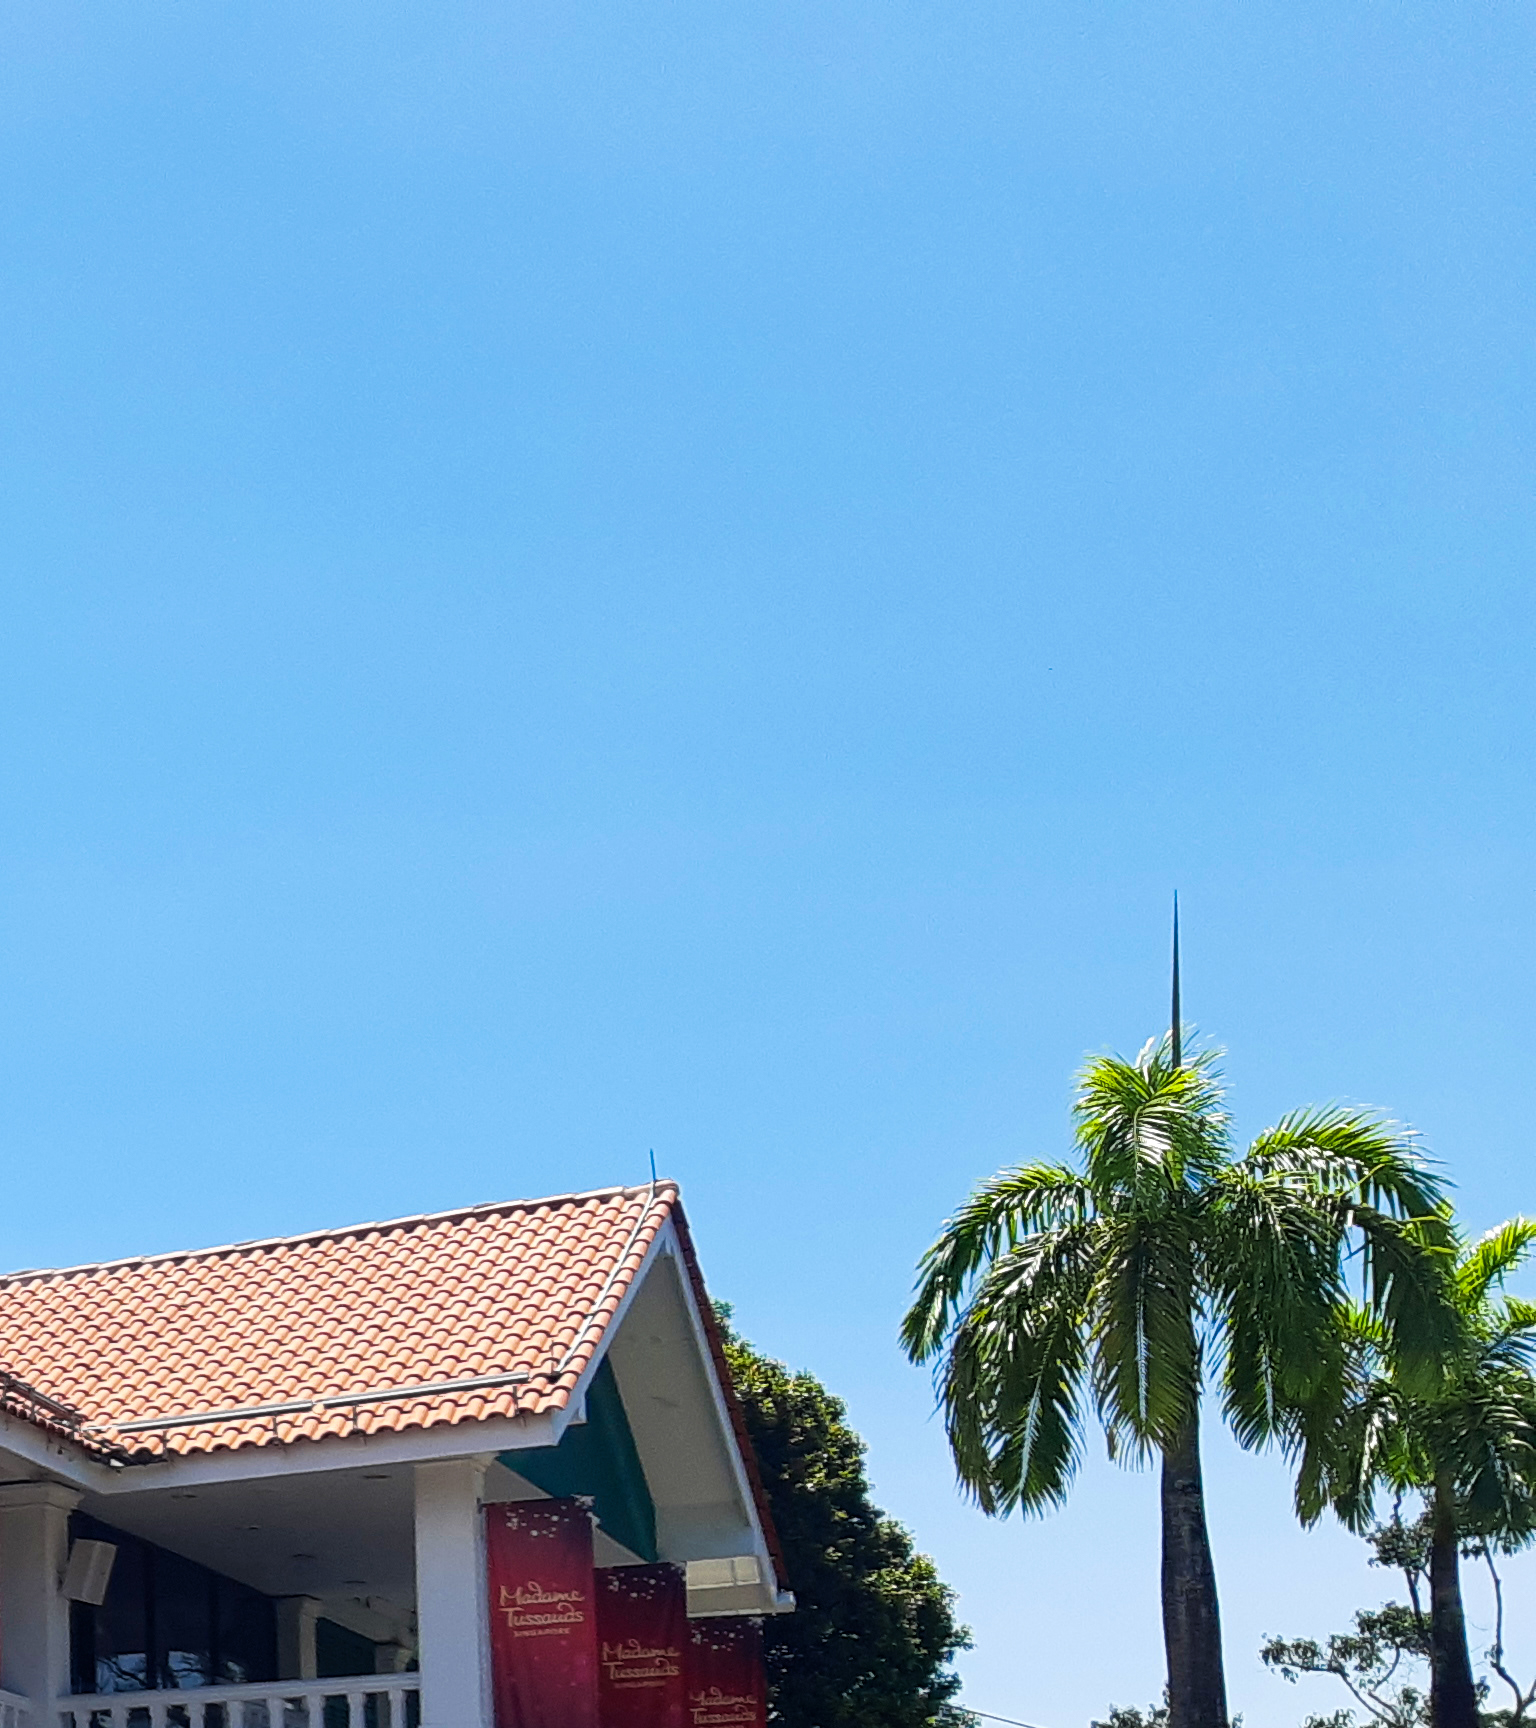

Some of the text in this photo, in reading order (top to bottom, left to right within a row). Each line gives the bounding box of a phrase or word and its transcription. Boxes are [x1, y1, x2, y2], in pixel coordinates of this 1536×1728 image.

[500, 1581, 585, 1606] Madame
[499, 1602, 584, 1627] Tussauds
[601, 1638, 680, 1661] Madame
[602, 1658, 680, 1680] Tussauds
